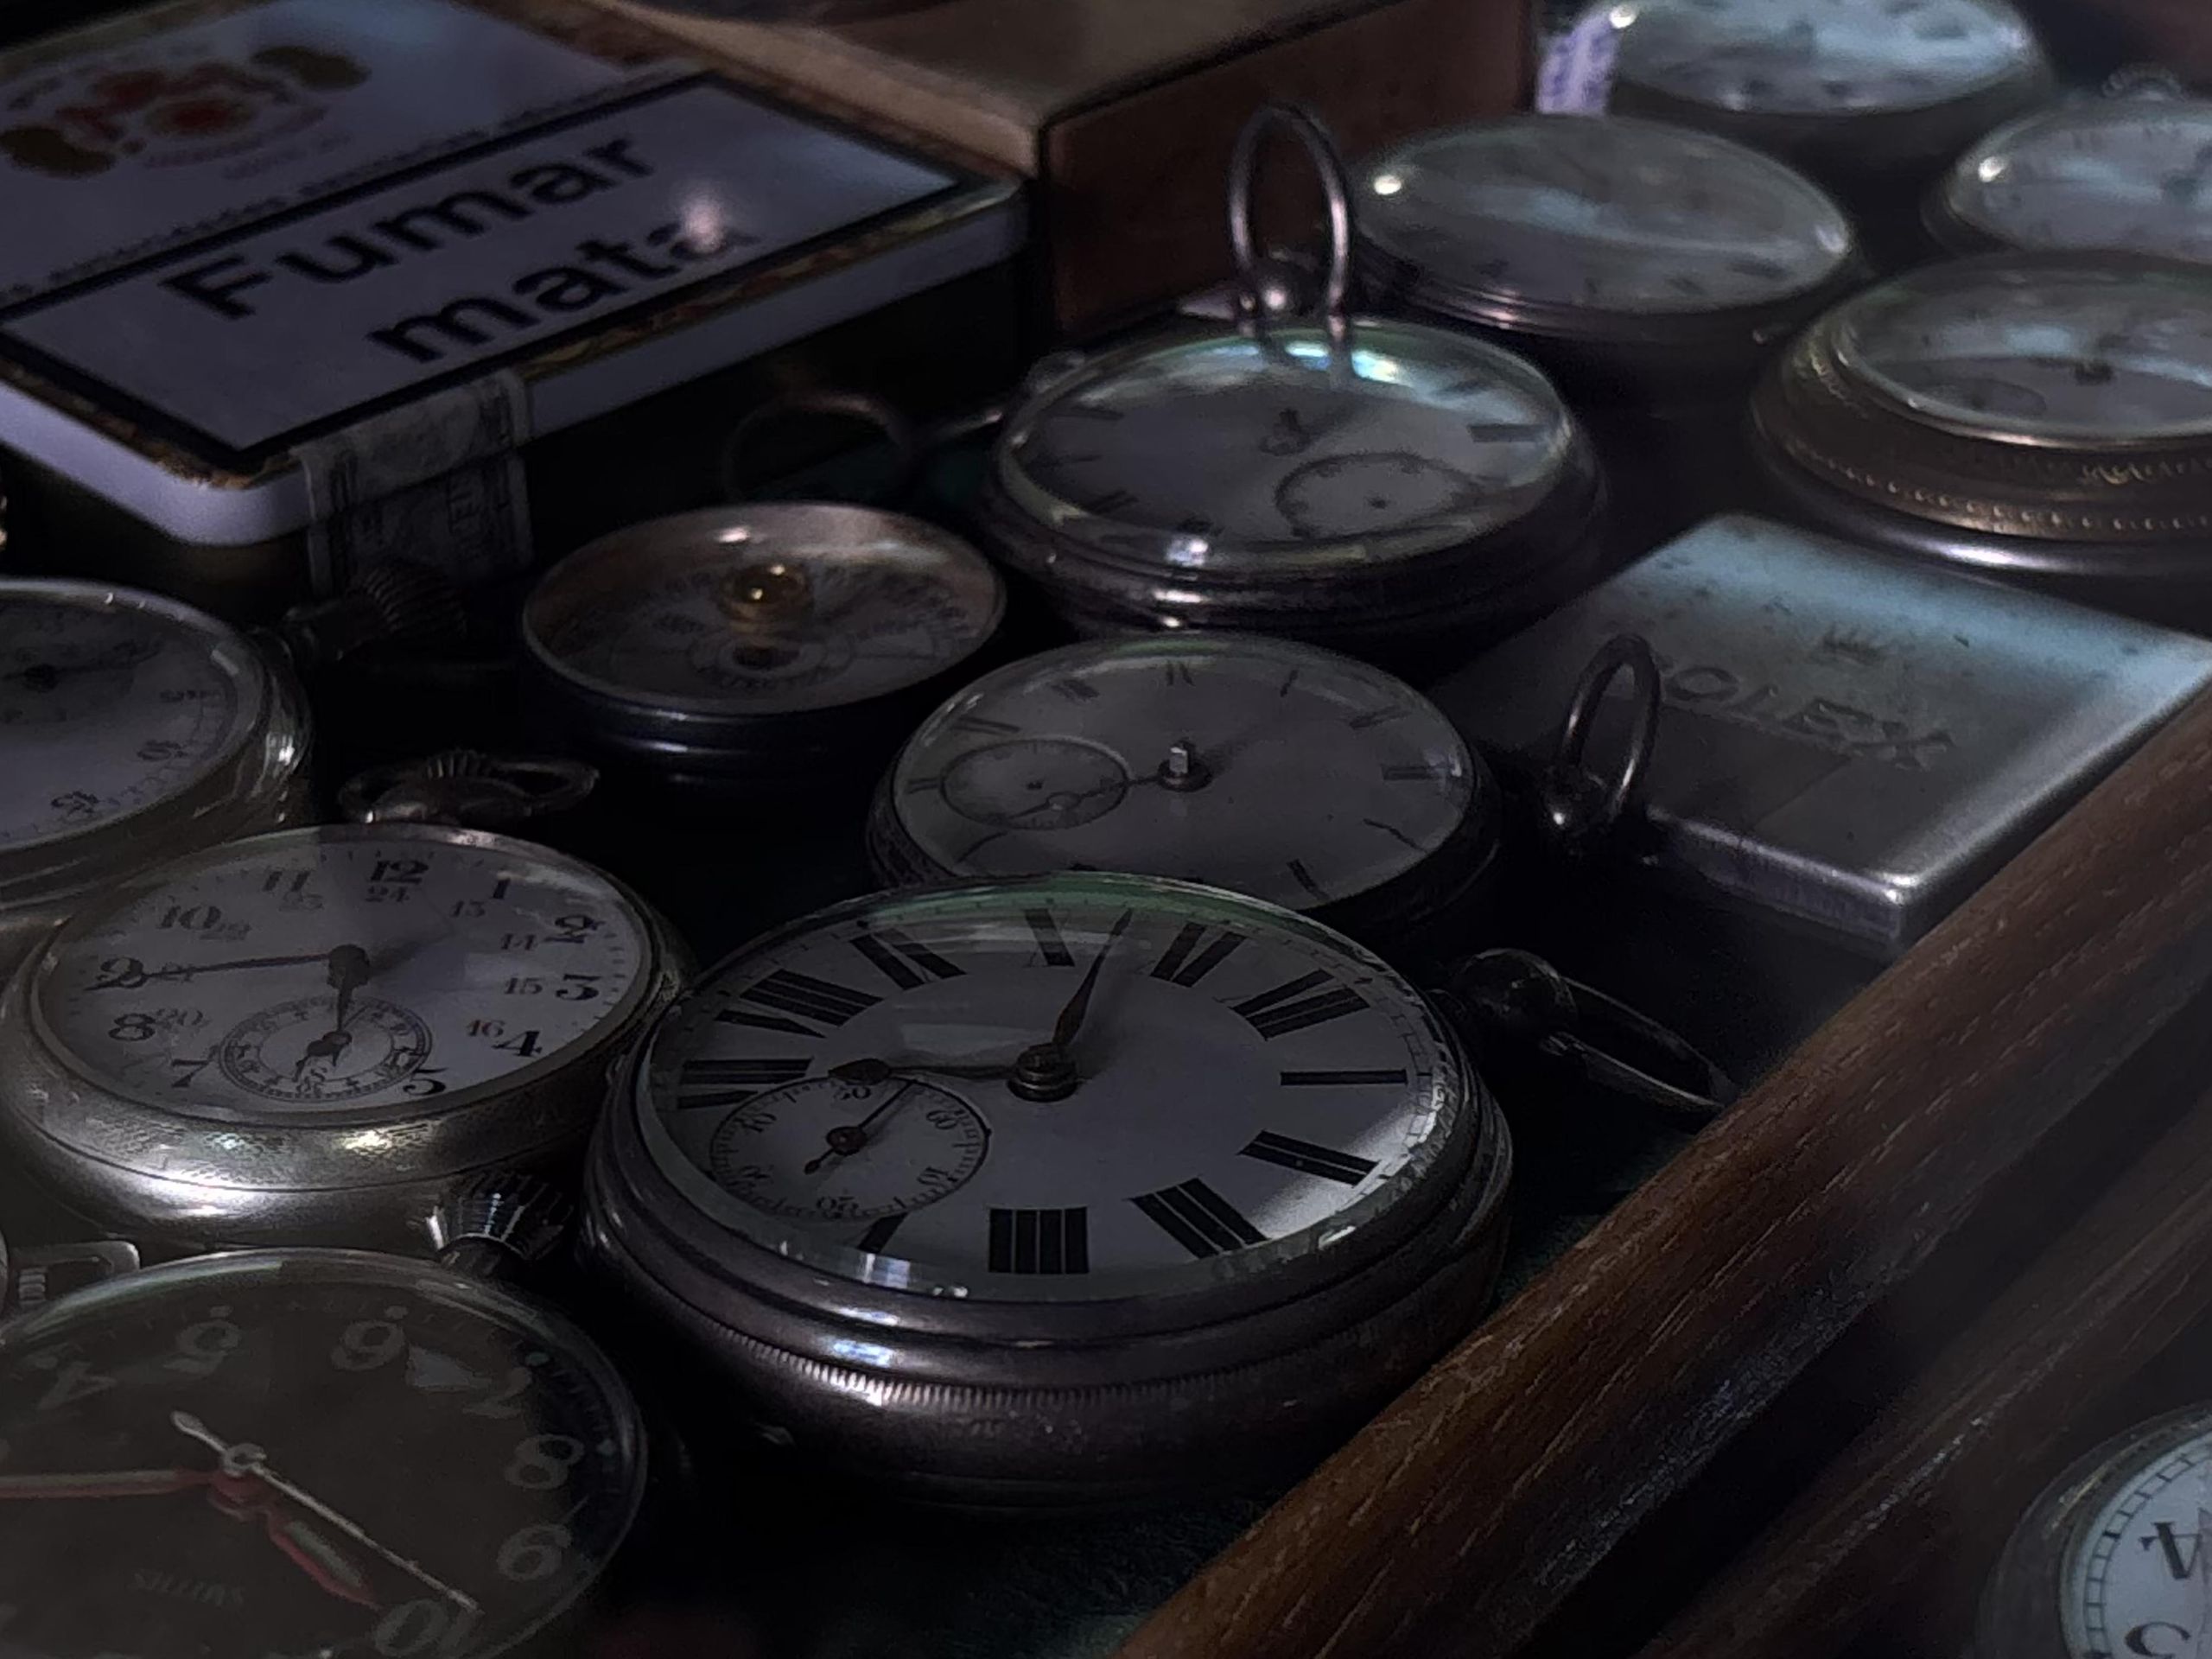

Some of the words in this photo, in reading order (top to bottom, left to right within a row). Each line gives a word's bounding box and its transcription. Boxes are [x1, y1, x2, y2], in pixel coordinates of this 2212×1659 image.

[159, 137, 656, 321] Fumar
[366, 220, 760, 363] mata
[370, 860, 429, 885] 12
[108, 1013, 156, 1041] 8
[493, 1030, 543, 1058] 4
[505, 1434, 585, 1489] 8
